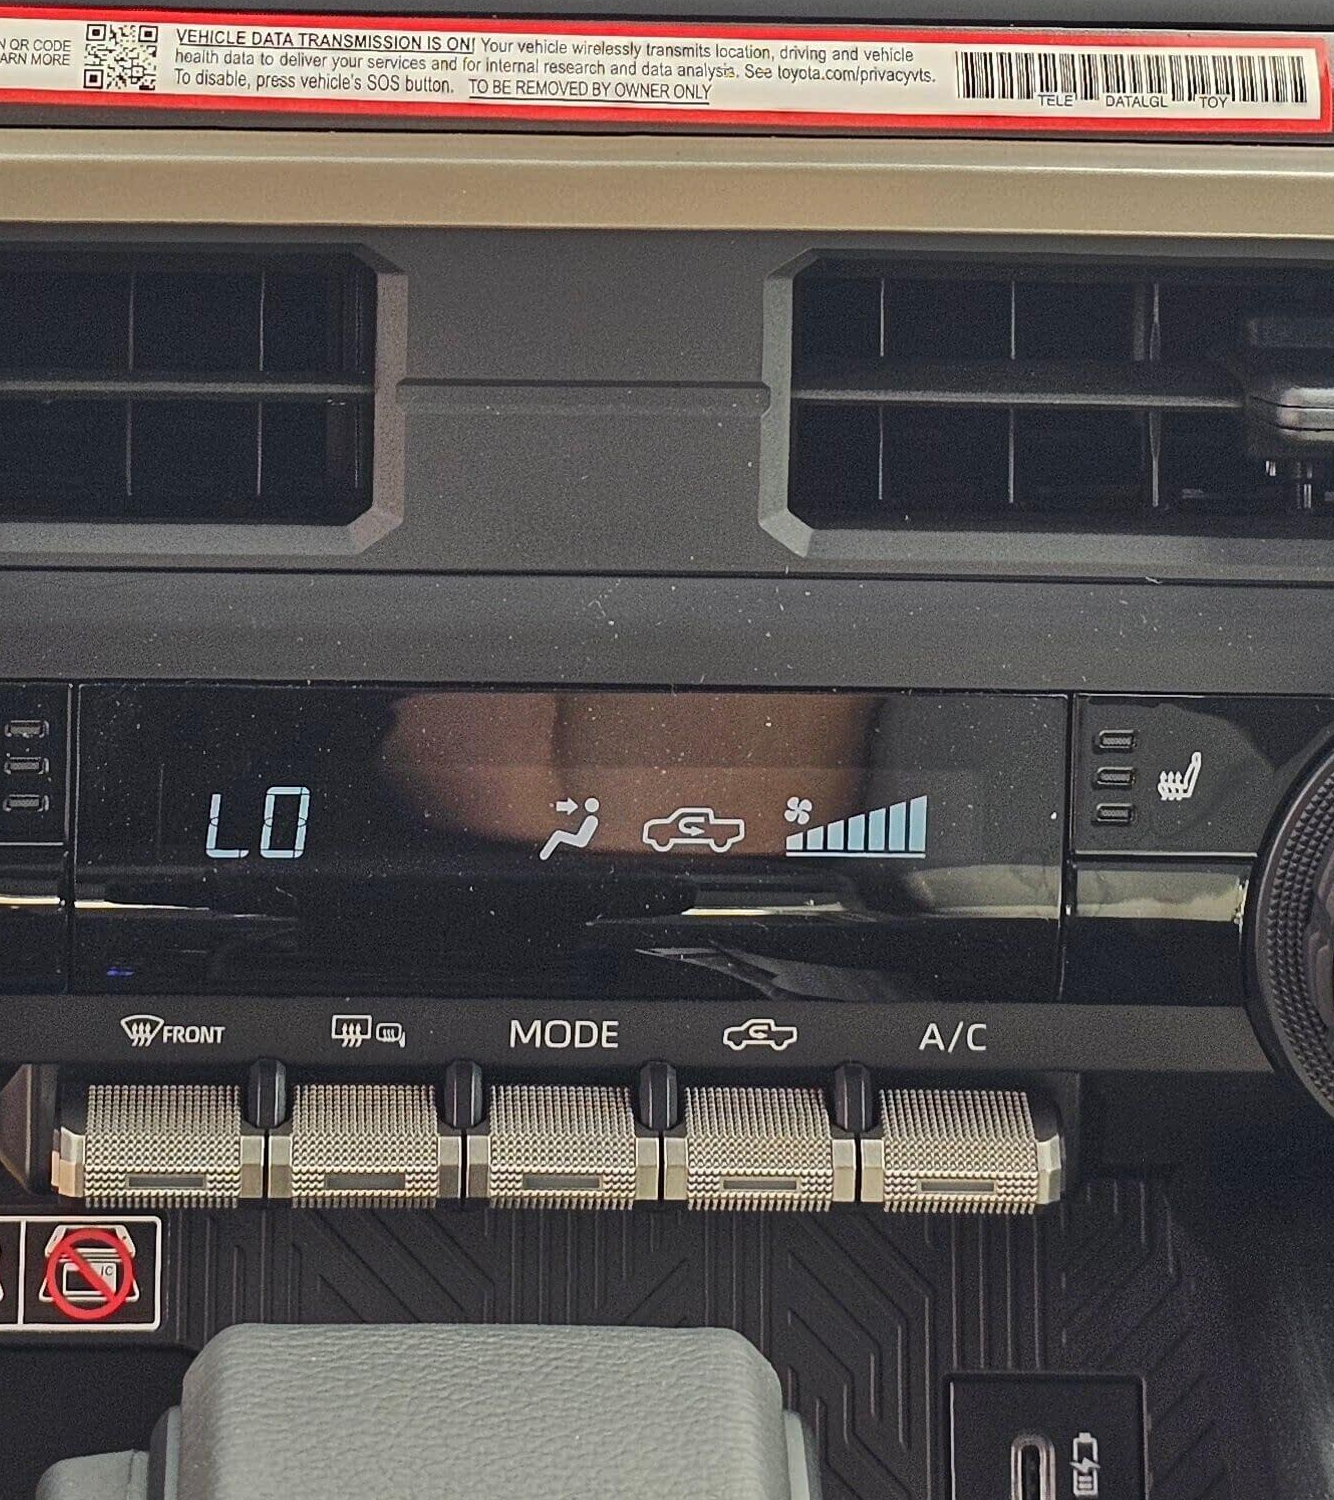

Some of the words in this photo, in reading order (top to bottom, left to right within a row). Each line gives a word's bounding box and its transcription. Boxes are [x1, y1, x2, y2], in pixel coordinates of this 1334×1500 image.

[10, 38, 30, 51] QR
[33, 38, 71, 52] CODE
[176, 28, 246, 45] VEHICLE
[252, 31, 294, 47] DATA
[299, 32, 421, 49] TRANSMISSION
[427, 36, 442, 51] IS
[481, 37, 514, 53] Your
[517, 39, 568, 54] vehicle
[572, 41, 642, 59] wirelessly
[646, 42, 711, 58] transmits
[715, 44, 775, 61] location,
[779, 45, 827, 63] driving
[832, 46, 859, 61] and
[864, 47, 914, 62] vehicle
[31, 53, 70, 66] MORE
[175, 47, 219, 65] health
[223, 51, 255, 66] data
[260, 53, 274, 66] to
[279, 52, 327, 68] deliver
[332, 56, 364, 72] your
[367, 56, 427, 71] services
[431, 57, 457, 72] and
[462, 56, 482, 72] for
[486, 59, 539, 74] internal
[543, 59, 605, 76] research
[610, 61, 637, 76] and
[641, 61, 673, 77] data
[744, 64, 772, 79] See
[777, 65, 936, 86] toyota.com/privacyvts.
[174, 68, 191, 85] To
[195, 70, 251, 89] disable,
[256, 75, 296, 92] press
[300, 74, 362, 91] vehicle's
[367, 73, 400, 92] SOS
[405, 76, 454, 94] button.
[468, 78, 489, 95] TO
[493, 79, 511, 95] BE
[515, 80, 588, 97] REMOVED
[593, 82, 611, 97] BY
[615, 82, 670, 98] OWNER
[673, 84, 712, 100] ONLY
[1038, 93, 1074, 107] TELE
[1199, 94, 1228, 109] TOY
[162, 1019, 225, 1043] FRONT
[510, 1020, 619, 1048] MODE
[919, 1021, 986, 1052] A/C
